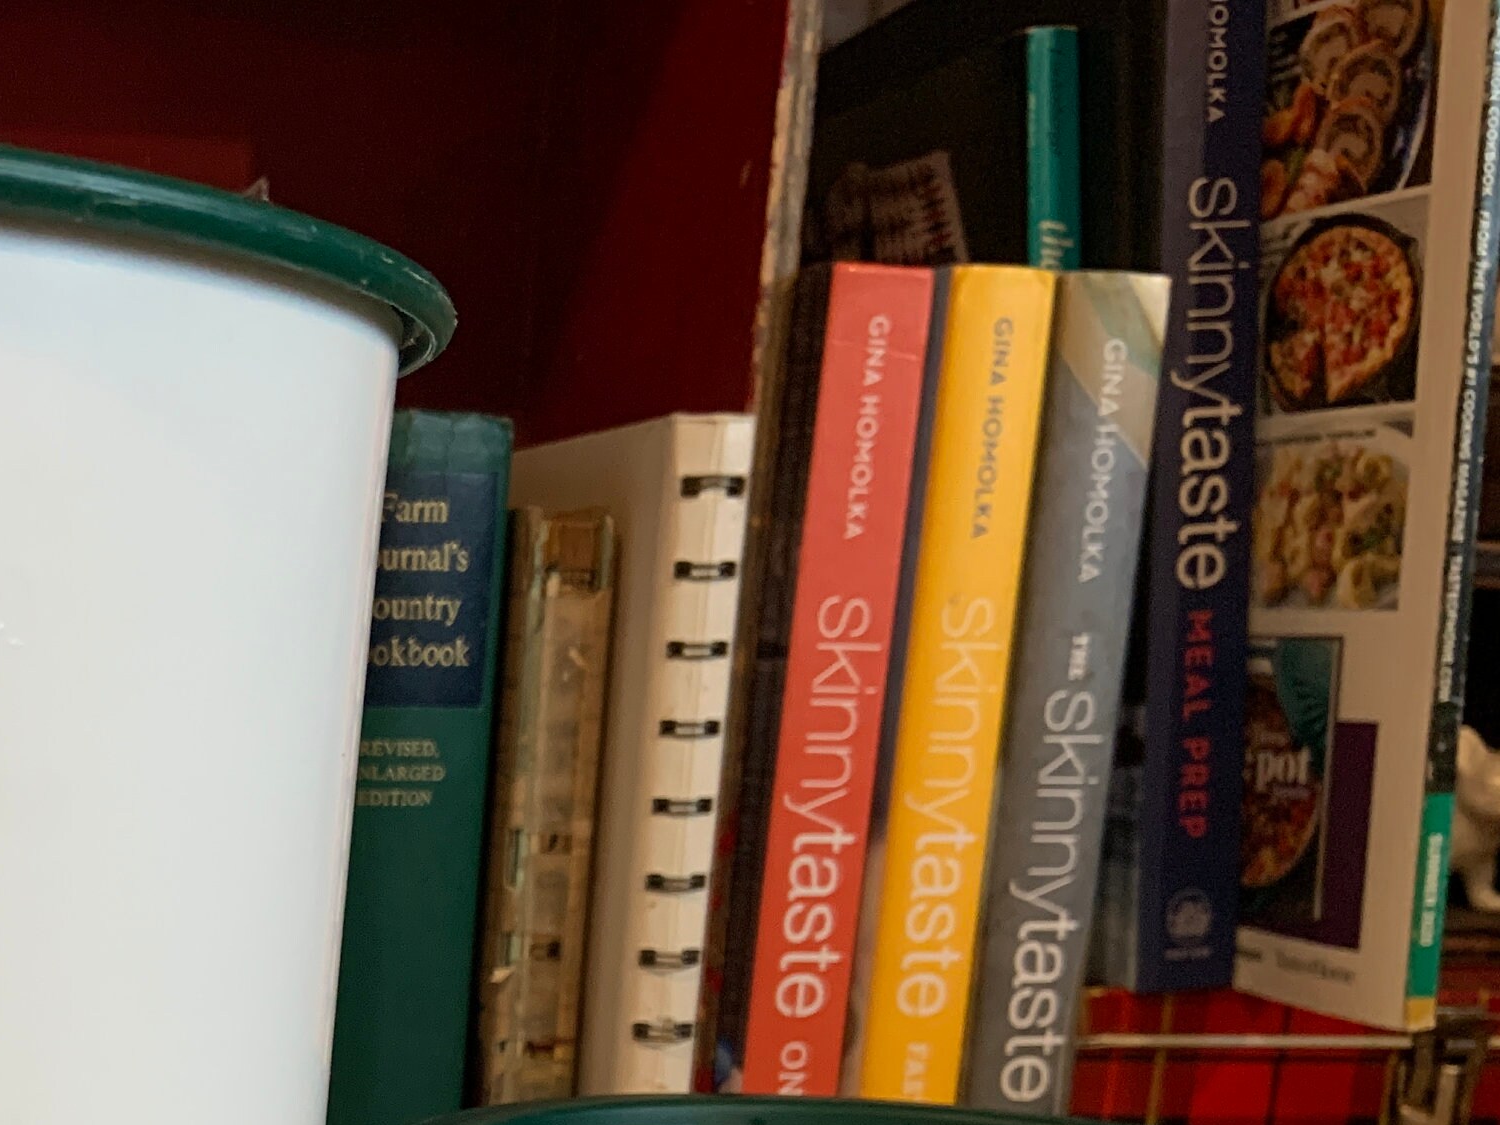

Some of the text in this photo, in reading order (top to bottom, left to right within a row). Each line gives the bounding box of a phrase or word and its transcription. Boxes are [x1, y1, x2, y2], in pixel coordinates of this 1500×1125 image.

[1206, 0, 1230, 122] OMOLKA
[1482, 106, 1500, 196] COOKBOOK
[844, 314, 891, 539] GINA HOMOLKA
[970, 317, 1014, 538] GINA HOMOLKA
[1077, 338, 1128, 583] GINA HOMOLKA
[379, 540, 470, 573] urnal's
[369, 634, 470, 668] okbook
[373, 592, 462, 627] ountry
[1181, 609, 1215, 721] MEAL
[359, 764, 446, 782] NLARGED
[1177, 736, 1212, 838] PREP
[777, 1041, 809, 1097] ON
